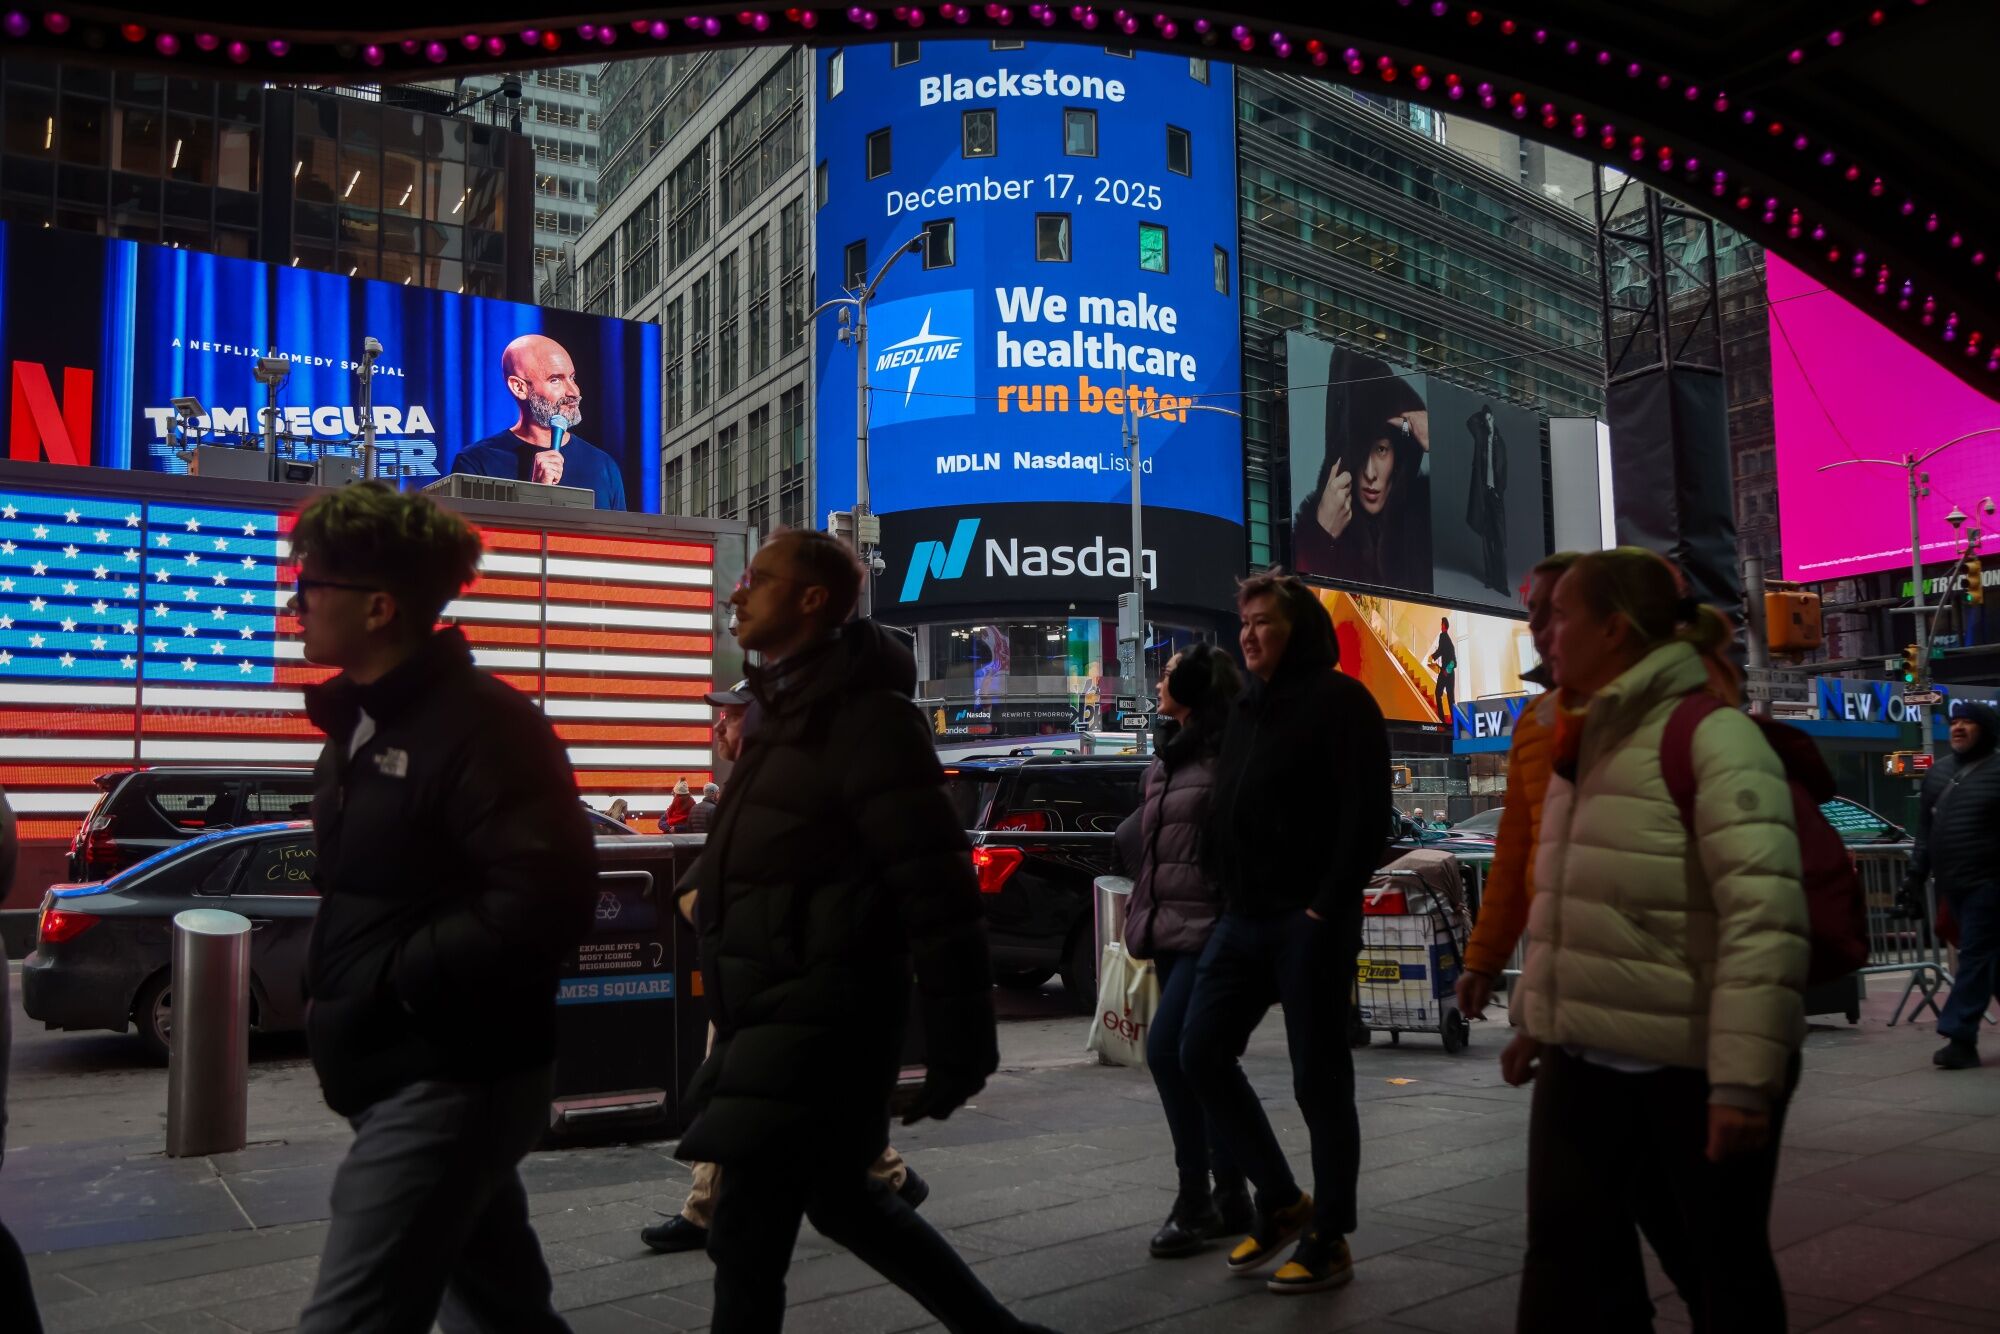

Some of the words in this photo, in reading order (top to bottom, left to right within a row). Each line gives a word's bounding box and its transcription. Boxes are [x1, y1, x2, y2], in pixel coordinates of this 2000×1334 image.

[919, 70, 1127, 107] Blackstone
[887, 176, 1035, 217] December
[1043, 173, 1084, 205] 17,
[1094, 177, 1162, 211] 2025
[995, 286, 1067, 323] We
[1079, 292, 1178, 334] make
[171, 338, 182, 348] A
[190, 340, 260, 357] NETFLIX
[268, 352, 334, 368] OMEDY
[341, 361, 405, 377] SPCIAL
[875, 341, 963, 372] MEDLINE
[996, 330, 1198, 382] healthcare
[9, 359, 94, 466] N
[997, 384, 1069, 413] run
[1078, 375, 1192, 423] better
[144, 407, 248, 438] TOM
[256, 406, 435, 436] SEGURA
[936, 453, 1001, 474] MDLN
[985, 536, 1158, 591] Nasdaq
[966, 711, 991, 720] Nasdaq
[1002, 711, 1031, 719] REWRITE
[1034, 711, 1070, 719] TOMORROW
[1816, 677, 1872, 721] NEW
[1872, 682, 1921, 722] YOR
[1452, 702, 1503, 740] NEW
[268, 845, 316, 861] Trun
[267, 861, 311, 881] Clea
[579, 944, 615, 952] EXPLORE
[617, 942, 640, 950] NYC'S
[579, 953, 602, 962] MOST
[604, 952, 632, 960] ICONIC
[579, 961, 642, 971] NEIGHBORHOOD
[558, 984, 599, 999] MES
[603, 979, 670, 996] SQUARE
